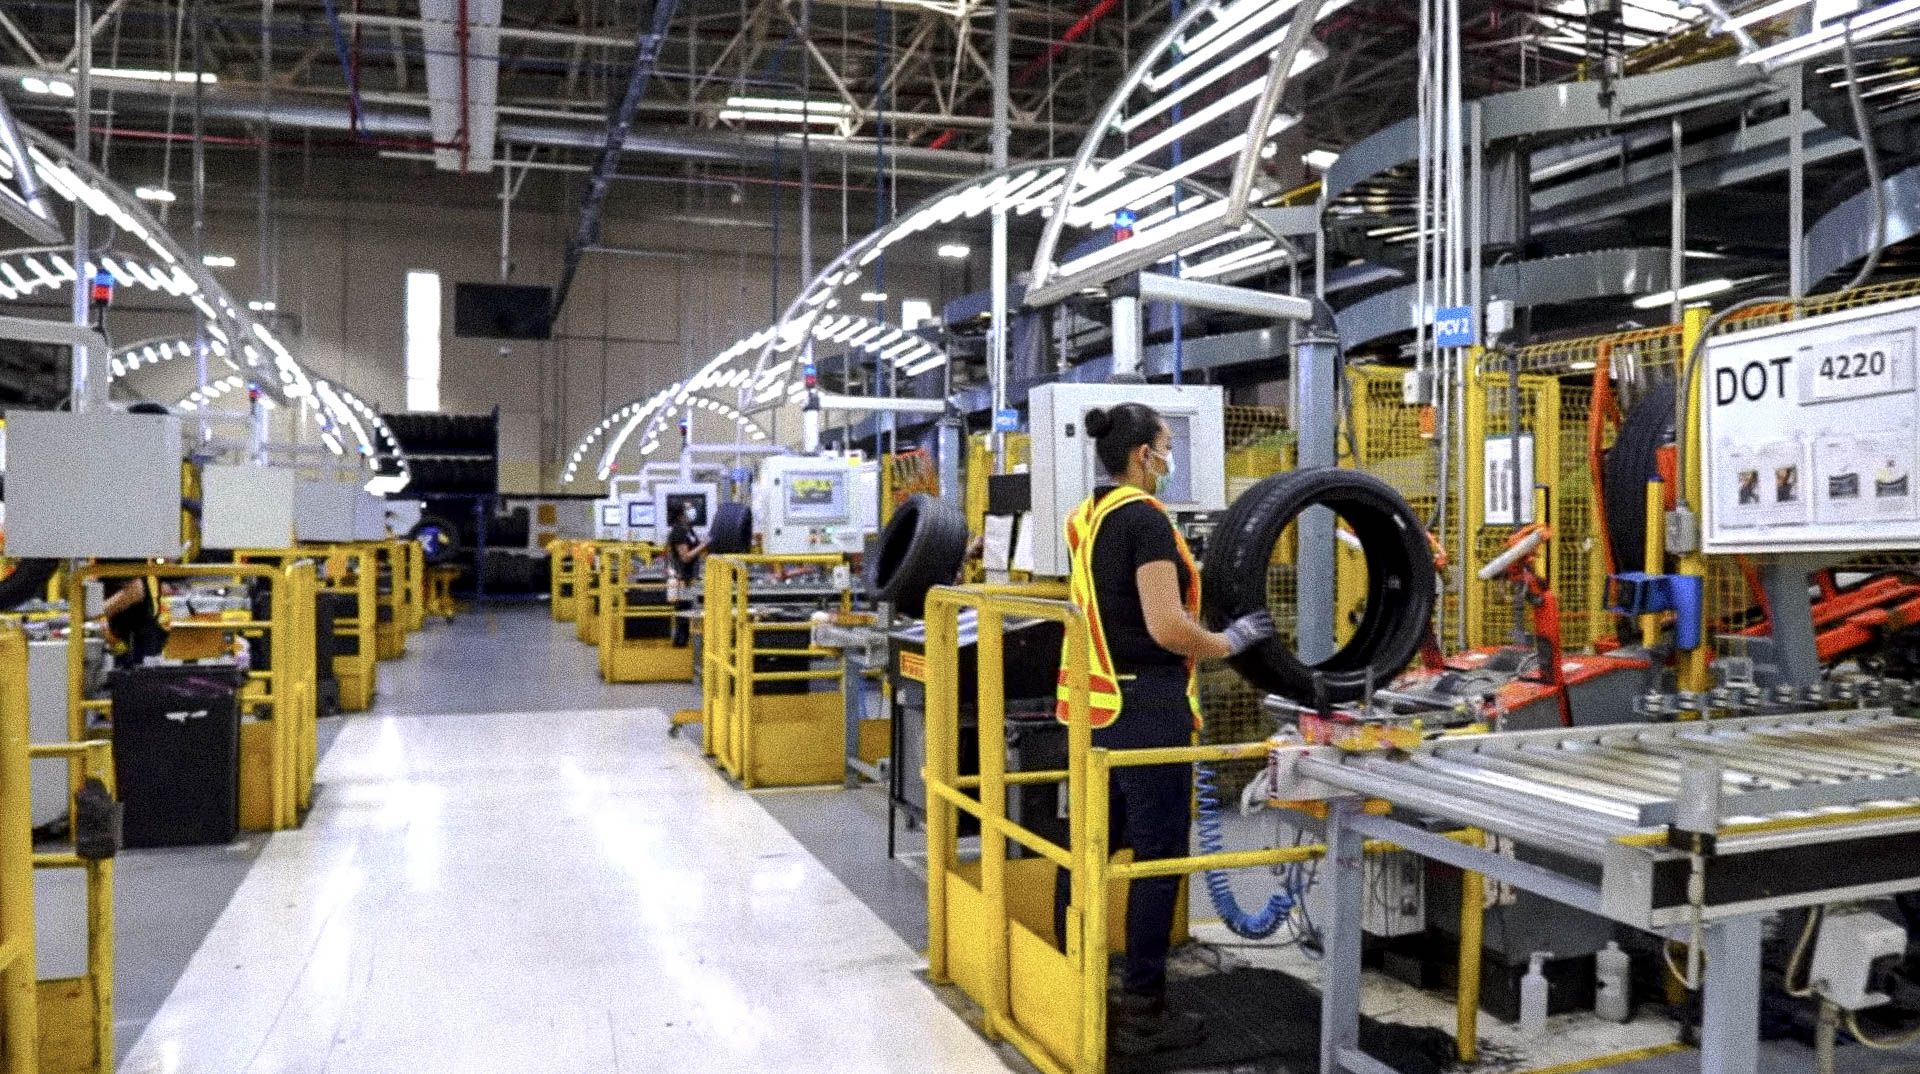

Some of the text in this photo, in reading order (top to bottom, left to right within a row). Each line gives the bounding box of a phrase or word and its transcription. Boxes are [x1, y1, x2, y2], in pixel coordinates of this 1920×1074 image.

[1437, 318, 1460, 336] PCV
[1716, 351, 1886, 406] DOT 4220
